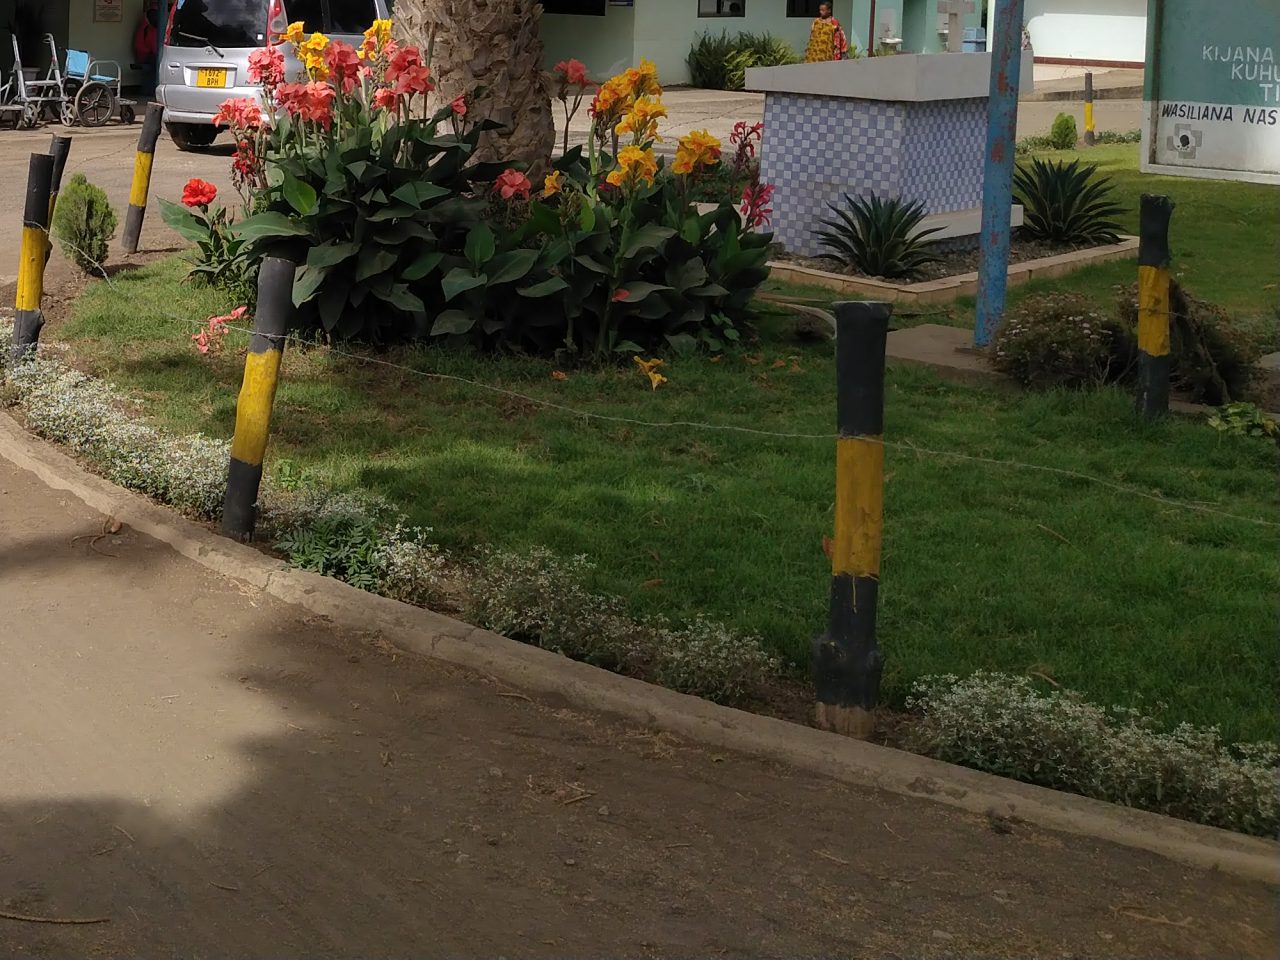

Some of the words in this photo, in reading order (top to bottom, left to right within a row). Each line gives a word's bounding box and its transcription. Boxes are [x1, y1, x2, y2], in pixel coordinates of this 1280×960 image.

[1202, 45, 1274, 64] KIJANA
[1162, 103, 1233, 122] WASILIANA
[1243, 108, 1278, 126] NAS
